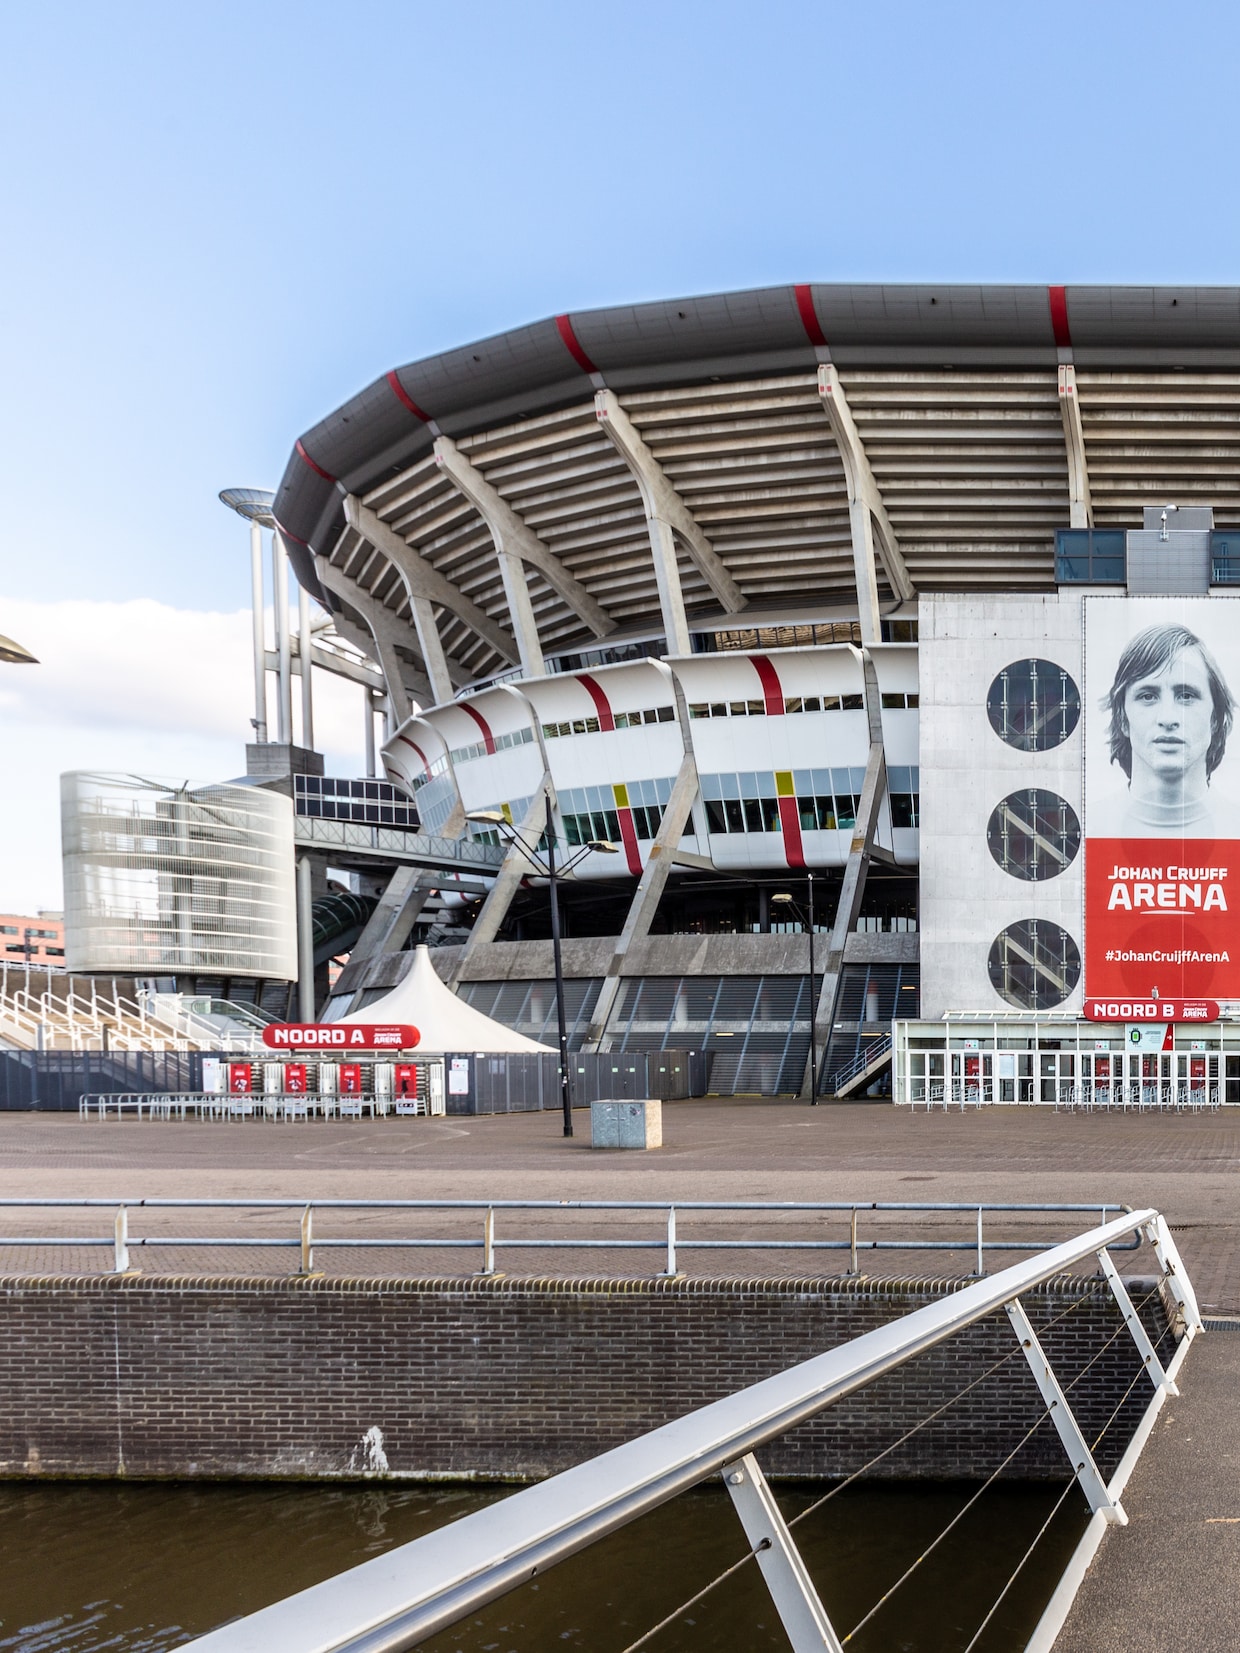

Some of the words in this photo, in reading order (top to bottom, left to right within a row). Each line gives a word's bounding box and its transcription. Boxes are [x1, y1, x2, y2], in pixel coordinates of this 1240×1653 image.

[1107, 865, 1163, 880] JOHAN
[1166, 865, 1228, 881] CRUIJFF
[1107, 882, 1228, 911] ARENA
[1105, 950, 1230, 964] #JohanCruijffArenA
[1094, 1003, 1157, 1017] NOORD
[1162, 1004, 1175, 1017] B
[274, 1029, 345, 1044] NOORD
[350, 1029, 365, 1044] A
